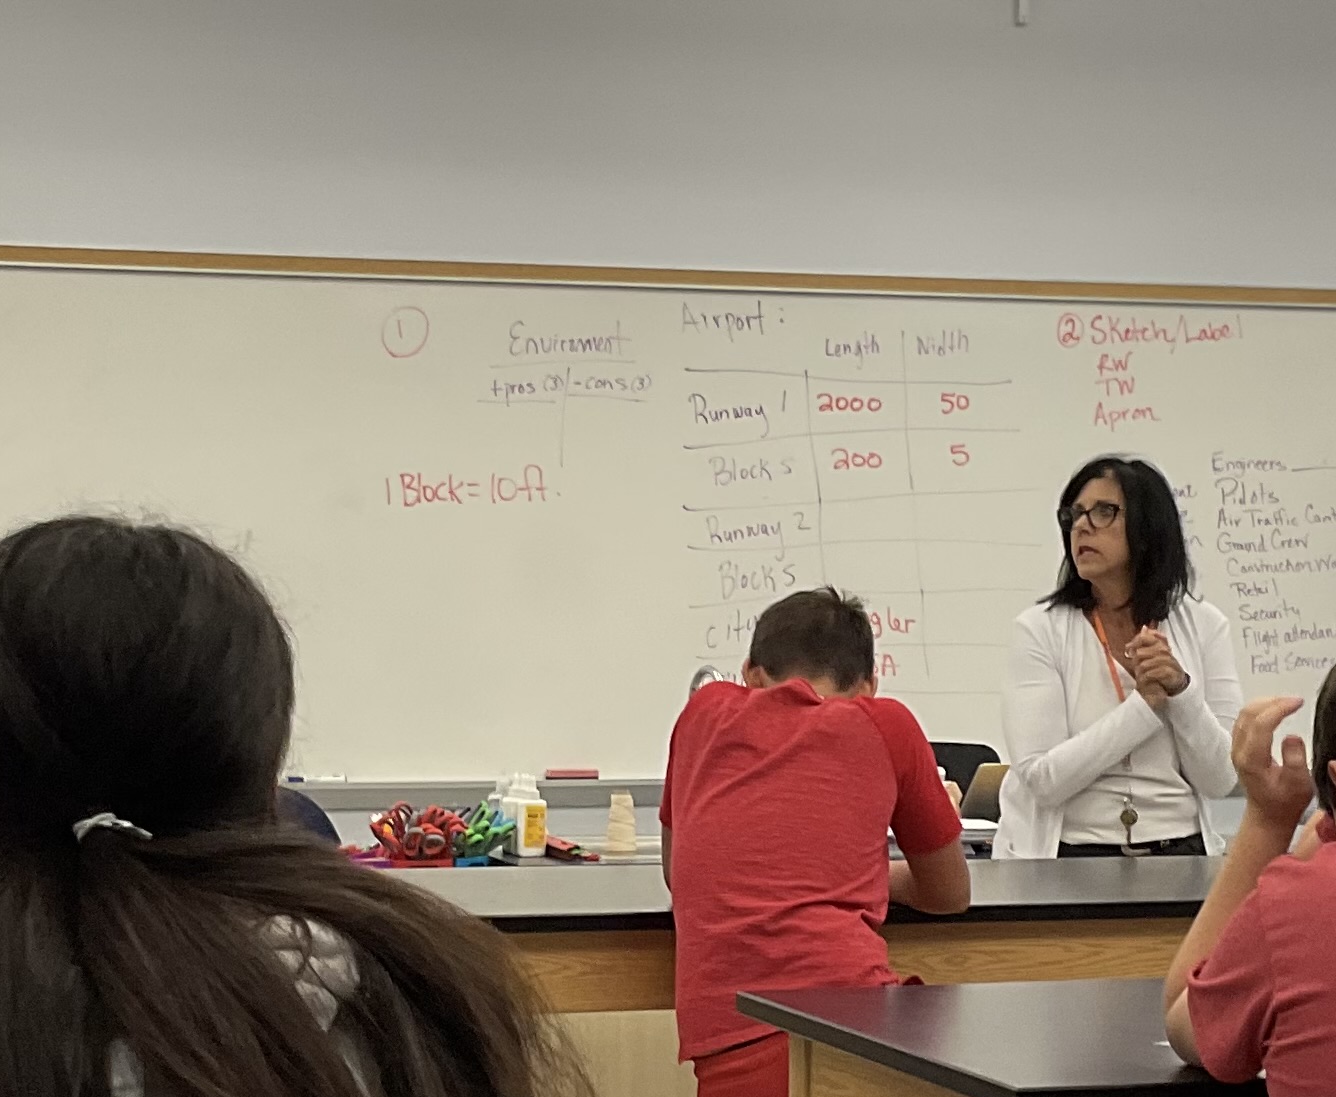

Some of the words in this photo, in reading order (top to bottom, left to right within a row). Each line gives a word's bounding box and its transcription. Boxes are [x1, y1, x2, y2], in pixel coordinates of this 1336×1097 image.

[824, 330, 880, 370] Length
[688, 392, 770, 439] Runway
[816, 391, 883, 413] 2000
[939, 391, 971, 416] 50
[1093, 400, 1162, 432] Apron
[830, 447, 883, 471] 200
[949, 442, 971, 467] 5
[1217, 506, 1242, 530] Air
[704, 514, 786, 564] Runway
[792, 510, 814, 531] 2
[717, 559, 798, 602] Blocks
